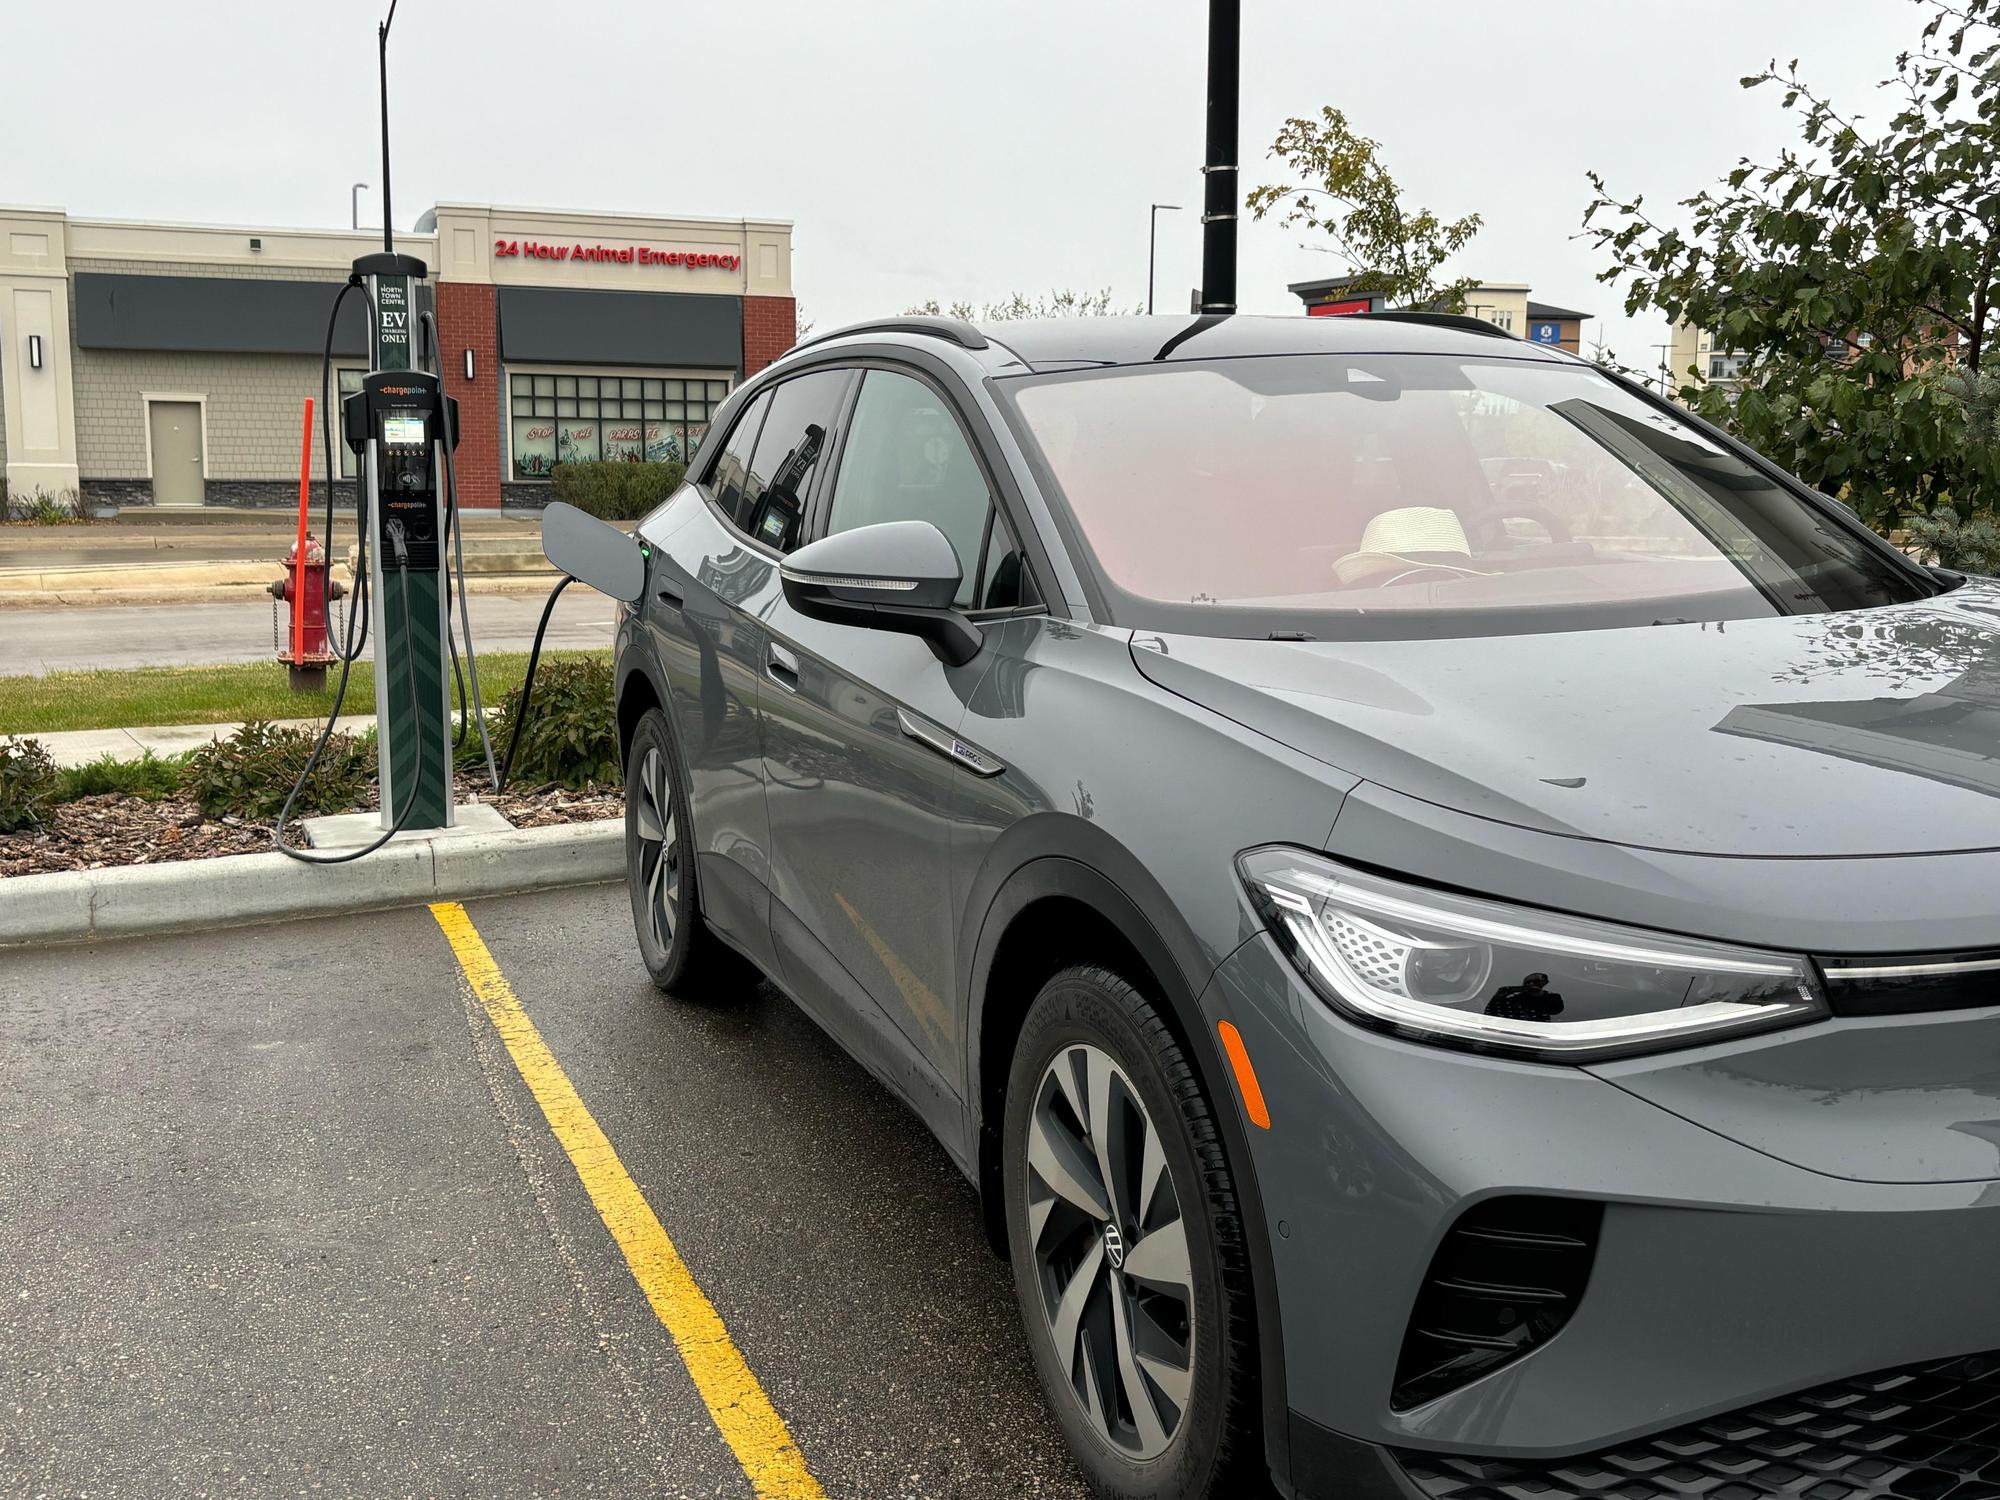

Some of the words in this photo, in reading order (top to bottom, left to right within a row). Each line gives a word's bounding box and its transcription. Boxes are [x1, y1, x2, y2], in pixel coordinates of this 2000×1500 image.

[495, 240, 519, 257] 24
[524, 241, 569, 260] Hour
[570, 244, 635, 264] Animal
[638, 247, 741, 271] Emergency
[380, 284, 403, 293] NORTH
[381, 311, 407, 328] EV
[381, 334, 407, 344] ONLY
[527, 427, 554, 440] STOP
[571, 427, 593, 440] THE
